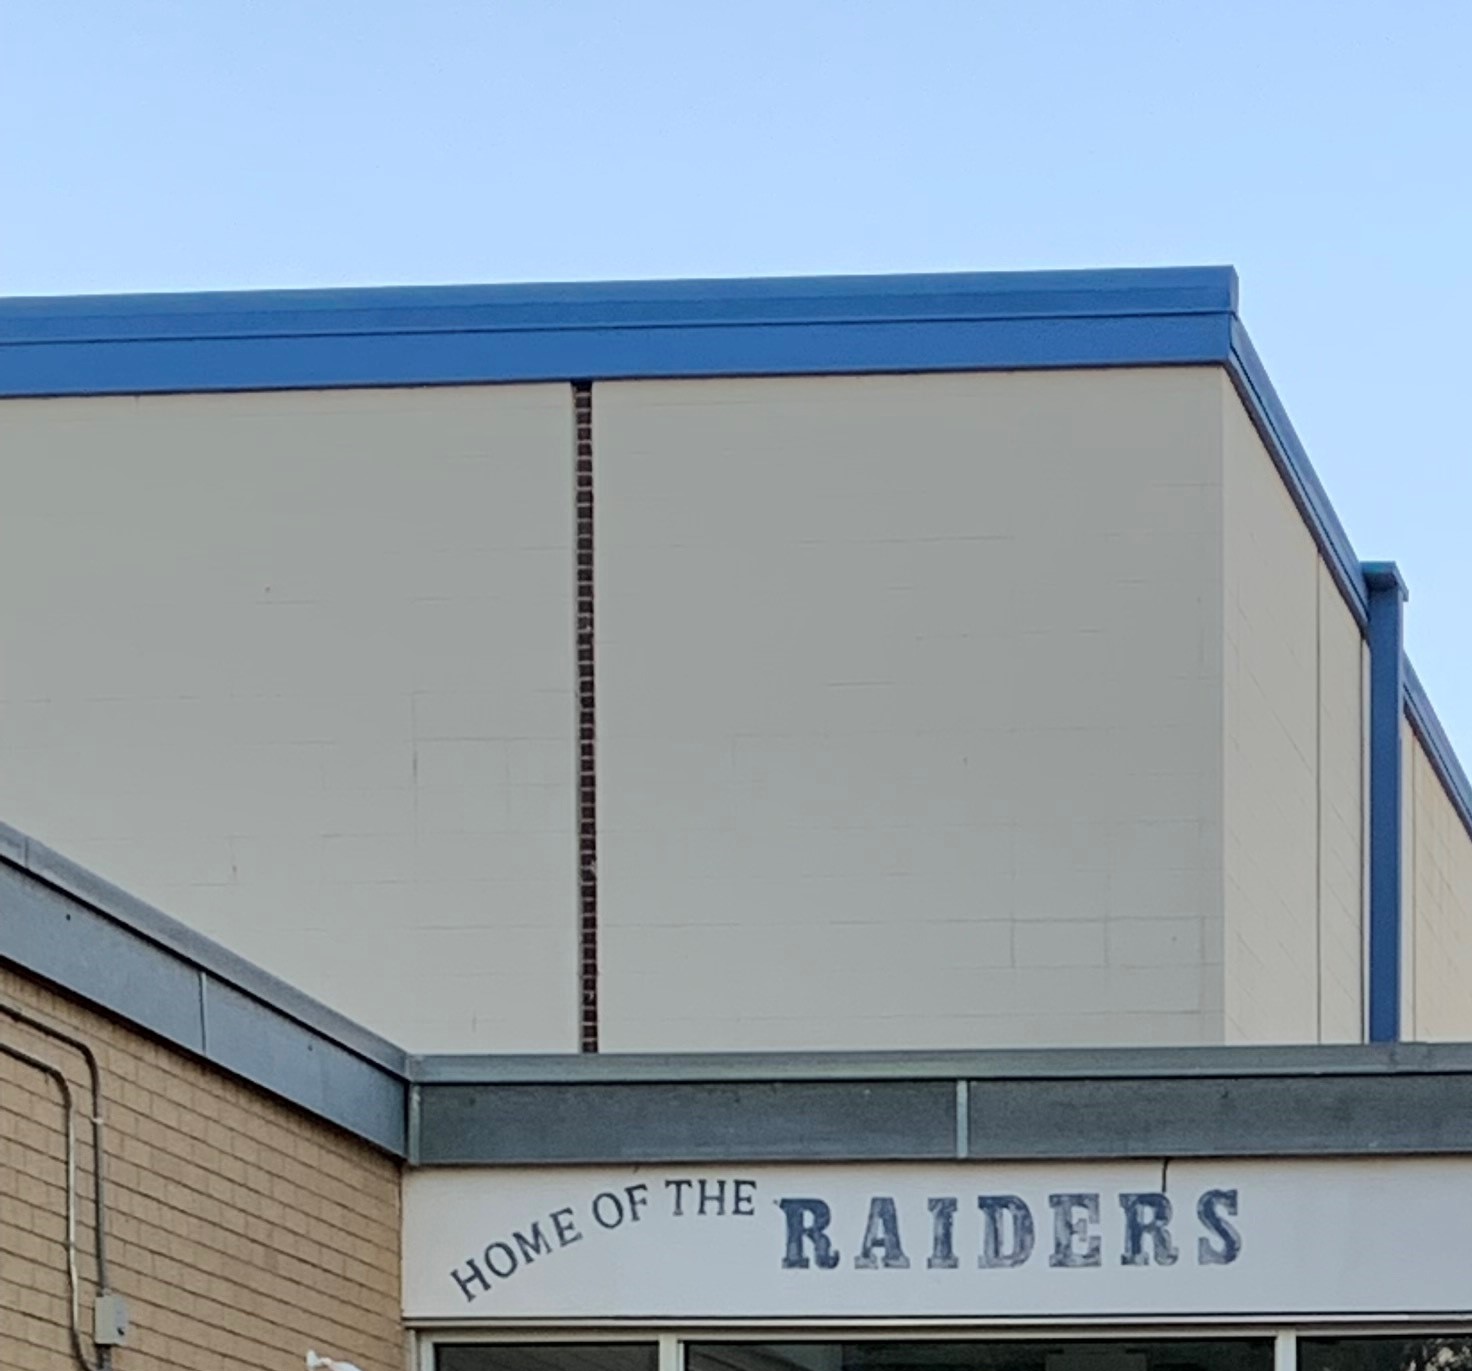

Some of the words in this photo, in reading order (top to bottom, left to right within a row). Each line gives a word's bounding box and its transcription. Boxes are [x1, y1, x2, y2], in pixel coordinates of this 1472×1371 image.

[451, 1208, 583, 1302] HOME
[592, 1184, 648, 1229] OF
[665, 1179, 757, 1216] THE
[779, 1188, 1241, 1270] RAIDERS
